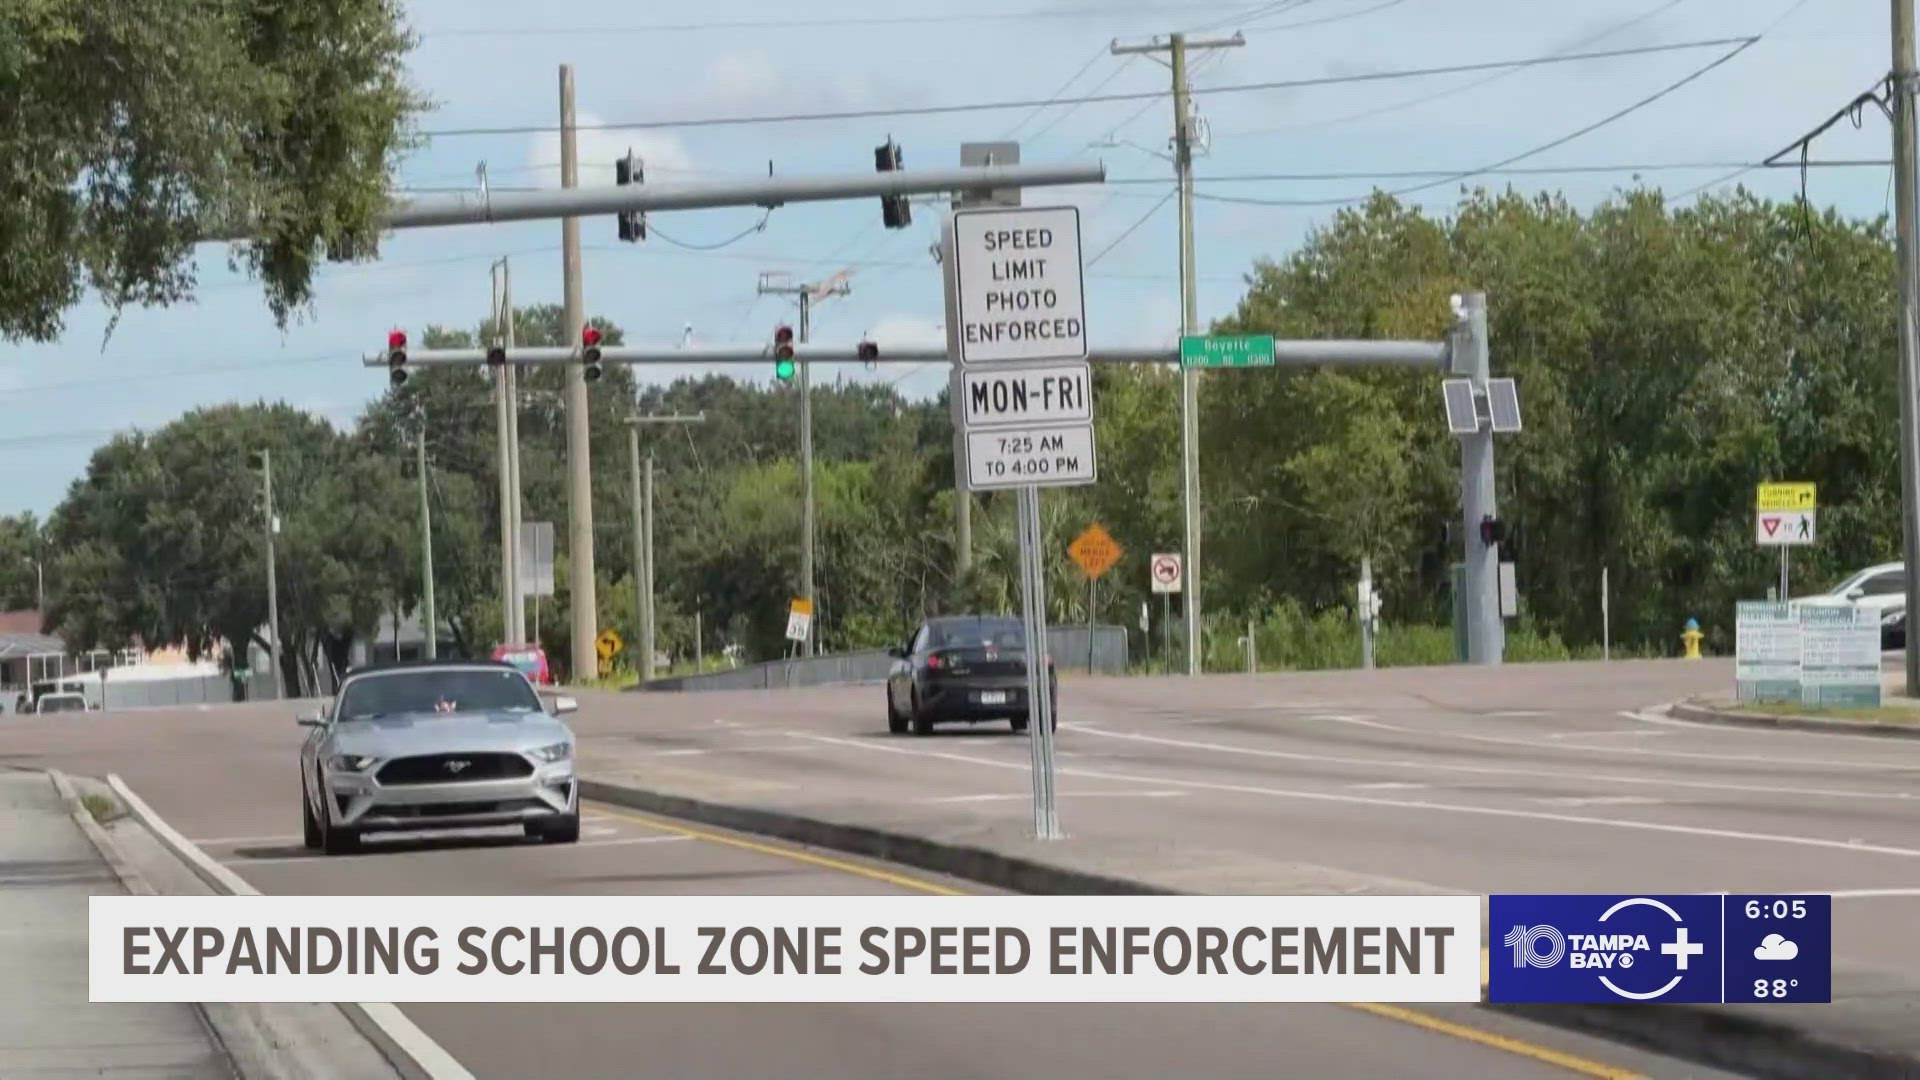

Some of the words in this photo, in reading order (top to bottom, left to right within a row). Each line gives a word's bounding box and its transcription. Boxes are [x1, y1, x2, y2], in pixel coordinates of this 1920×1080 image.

[984, 229, 1052, 250] SPEED
[992, 259, 1047, 281] LIMIT
[986, 290, 1057, 311] PHOTO
[966, 319, 1081, 343] ENFORCED
[971, 375, 1084, 415] MON-FRI
[999, 438, 1033, 454] 7:25
[1040, 436, 1064, 452] AM
[986, 460, 1005, 477] TO
[1012, 459, 1050, 475] 4:00
[1056, 457, 1079, 474] PM
